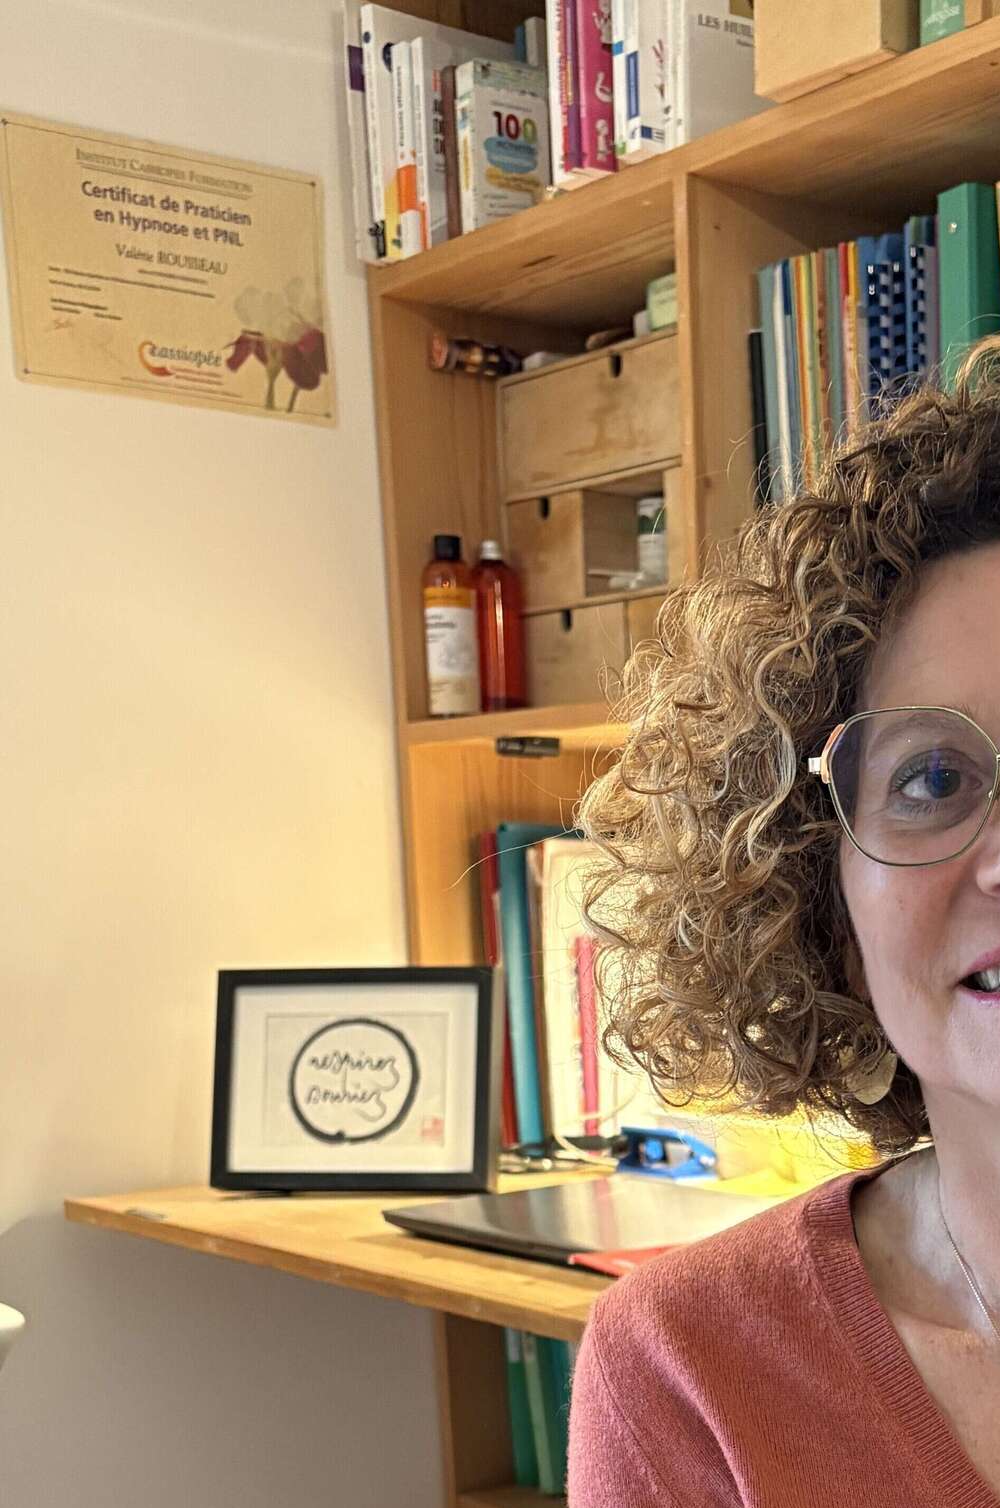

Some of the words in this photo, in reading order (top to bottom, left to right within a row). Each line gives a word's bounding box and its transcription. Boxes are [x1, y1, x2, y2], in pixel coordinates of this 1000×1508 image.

[493, 110, 538, 144] 100
[81, 180, 155, 208] Certificat
[160, 195, 180, 213] de
[184, 199, 252, 226] Praticien
[94, 209, 115, 224] en
[119, 210, 189, 237] Hypnose
[193, 227, 209, 241] et
